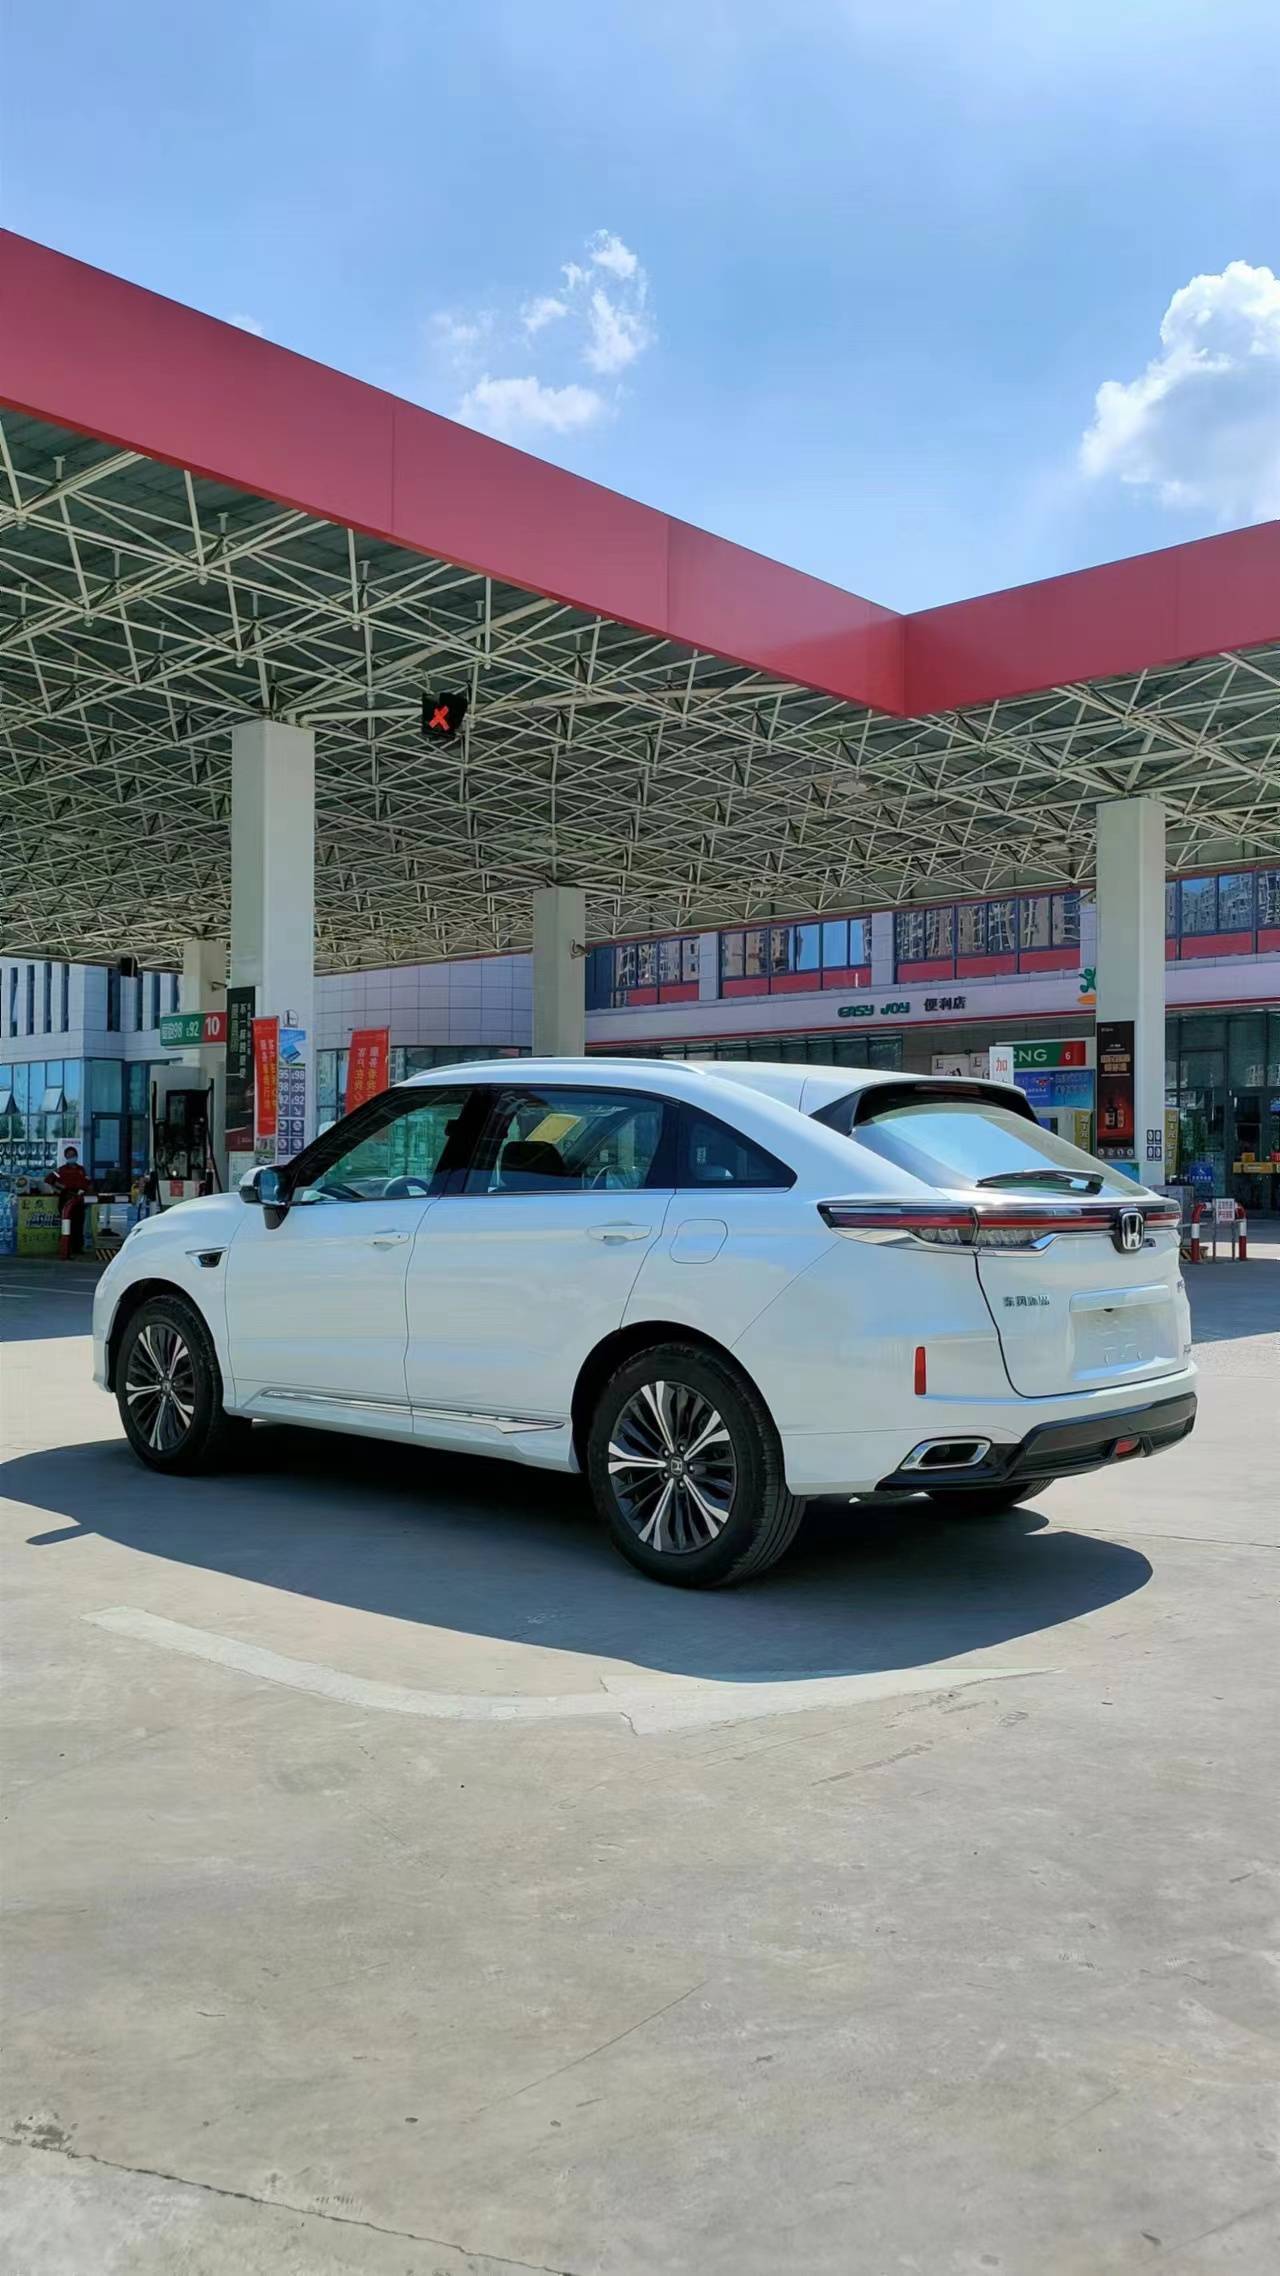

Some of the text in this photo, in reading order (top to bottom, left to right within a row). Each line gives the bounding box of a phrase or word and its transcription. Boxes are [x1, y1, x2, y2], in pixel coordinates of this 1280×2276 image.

[838, 996, 966, 1018] EASY JOY 便利店
[205, 1016, 220, 1036] 10
[1014, 1049, 1047, 1062] NG
[1065, 1052, 1071, 1060] 6
